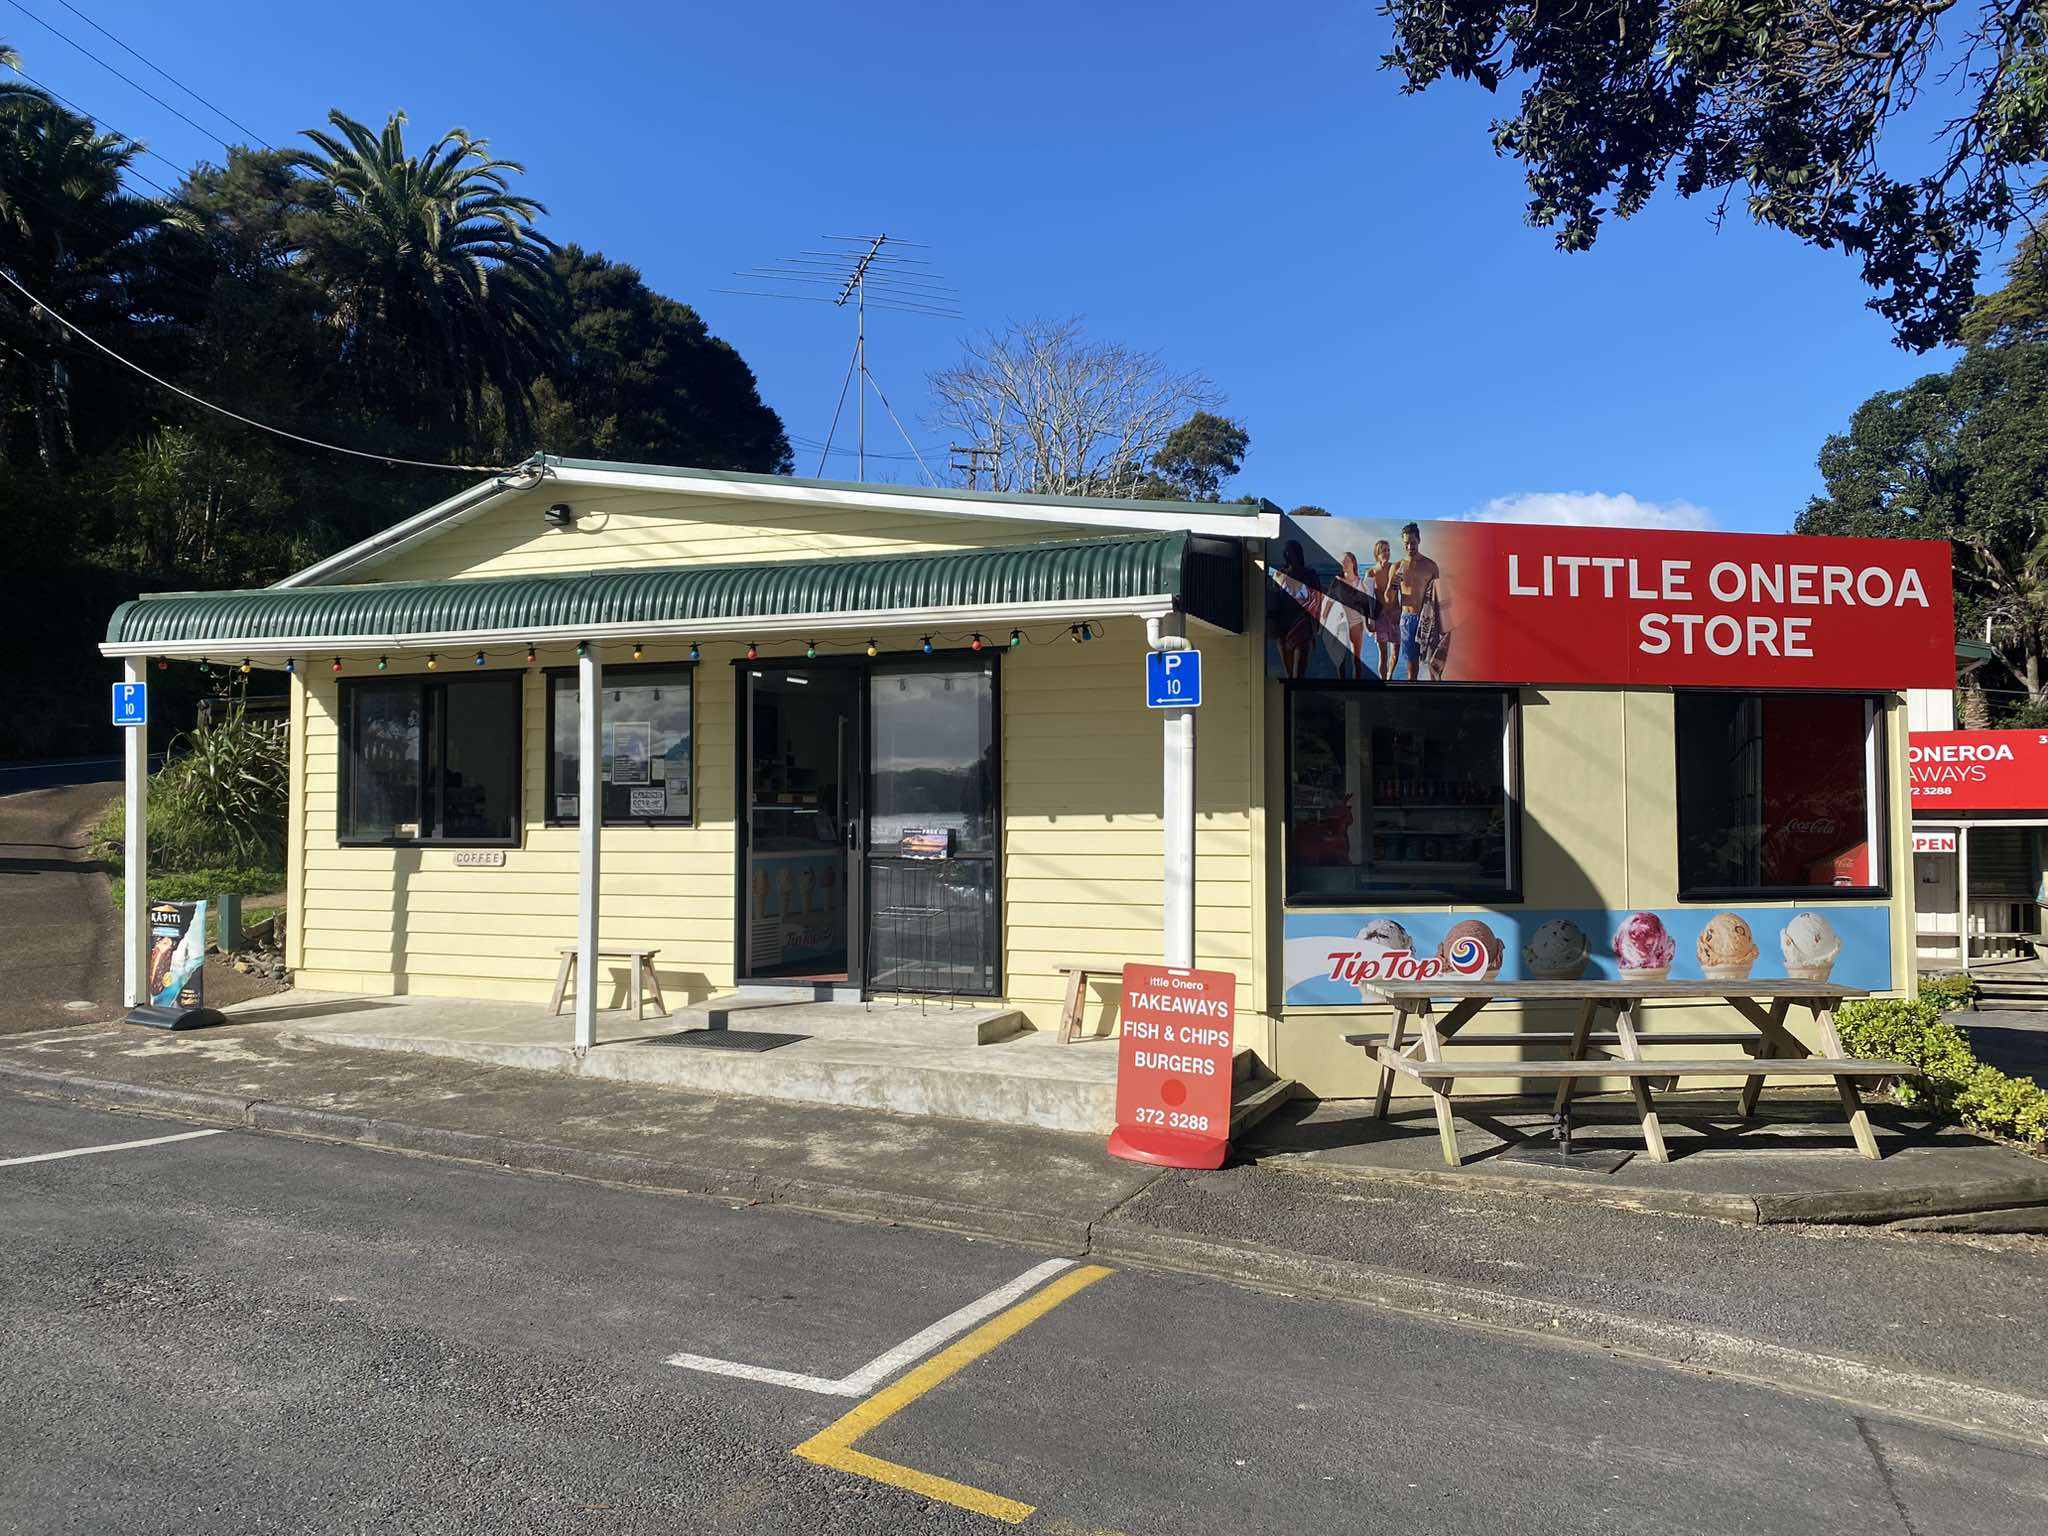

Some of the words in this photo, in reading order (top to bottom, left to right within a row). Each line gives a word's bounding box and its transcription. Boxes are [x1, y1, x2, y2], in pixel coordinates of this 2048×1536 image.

[1508, 554, 1693, 601] LITTLE
[1709, 561, 1930, 608] ONEROA
[1638, 613, 1814, 657] STORE
[1165, 655, 1182, 675] P
[124, 686, 135, 701] P
[1167, 679, 1181, 695] 10
[126, 703, 135, 715] 10
[1908, 744, 2014, 763] ONEROA
[1923, 786, 1952, 795] 3288
[1911, 838, 1954, 850] PEN
[456, 853, 499, 863] COFFEE
[1129, 991, 1229, 1018] TAKEAWAYS
[1123, 1021, 1159, 1040] FISH
[1164, 1025, 1175, 1041] &
[1180, 1027, 1229, 1047] CHIPS
[1135, 1051, 1215, 1076] BURGERS
[1136, 1107, 1165, 1125] 372
[1169, 1112, 1208, 1131] 3288
